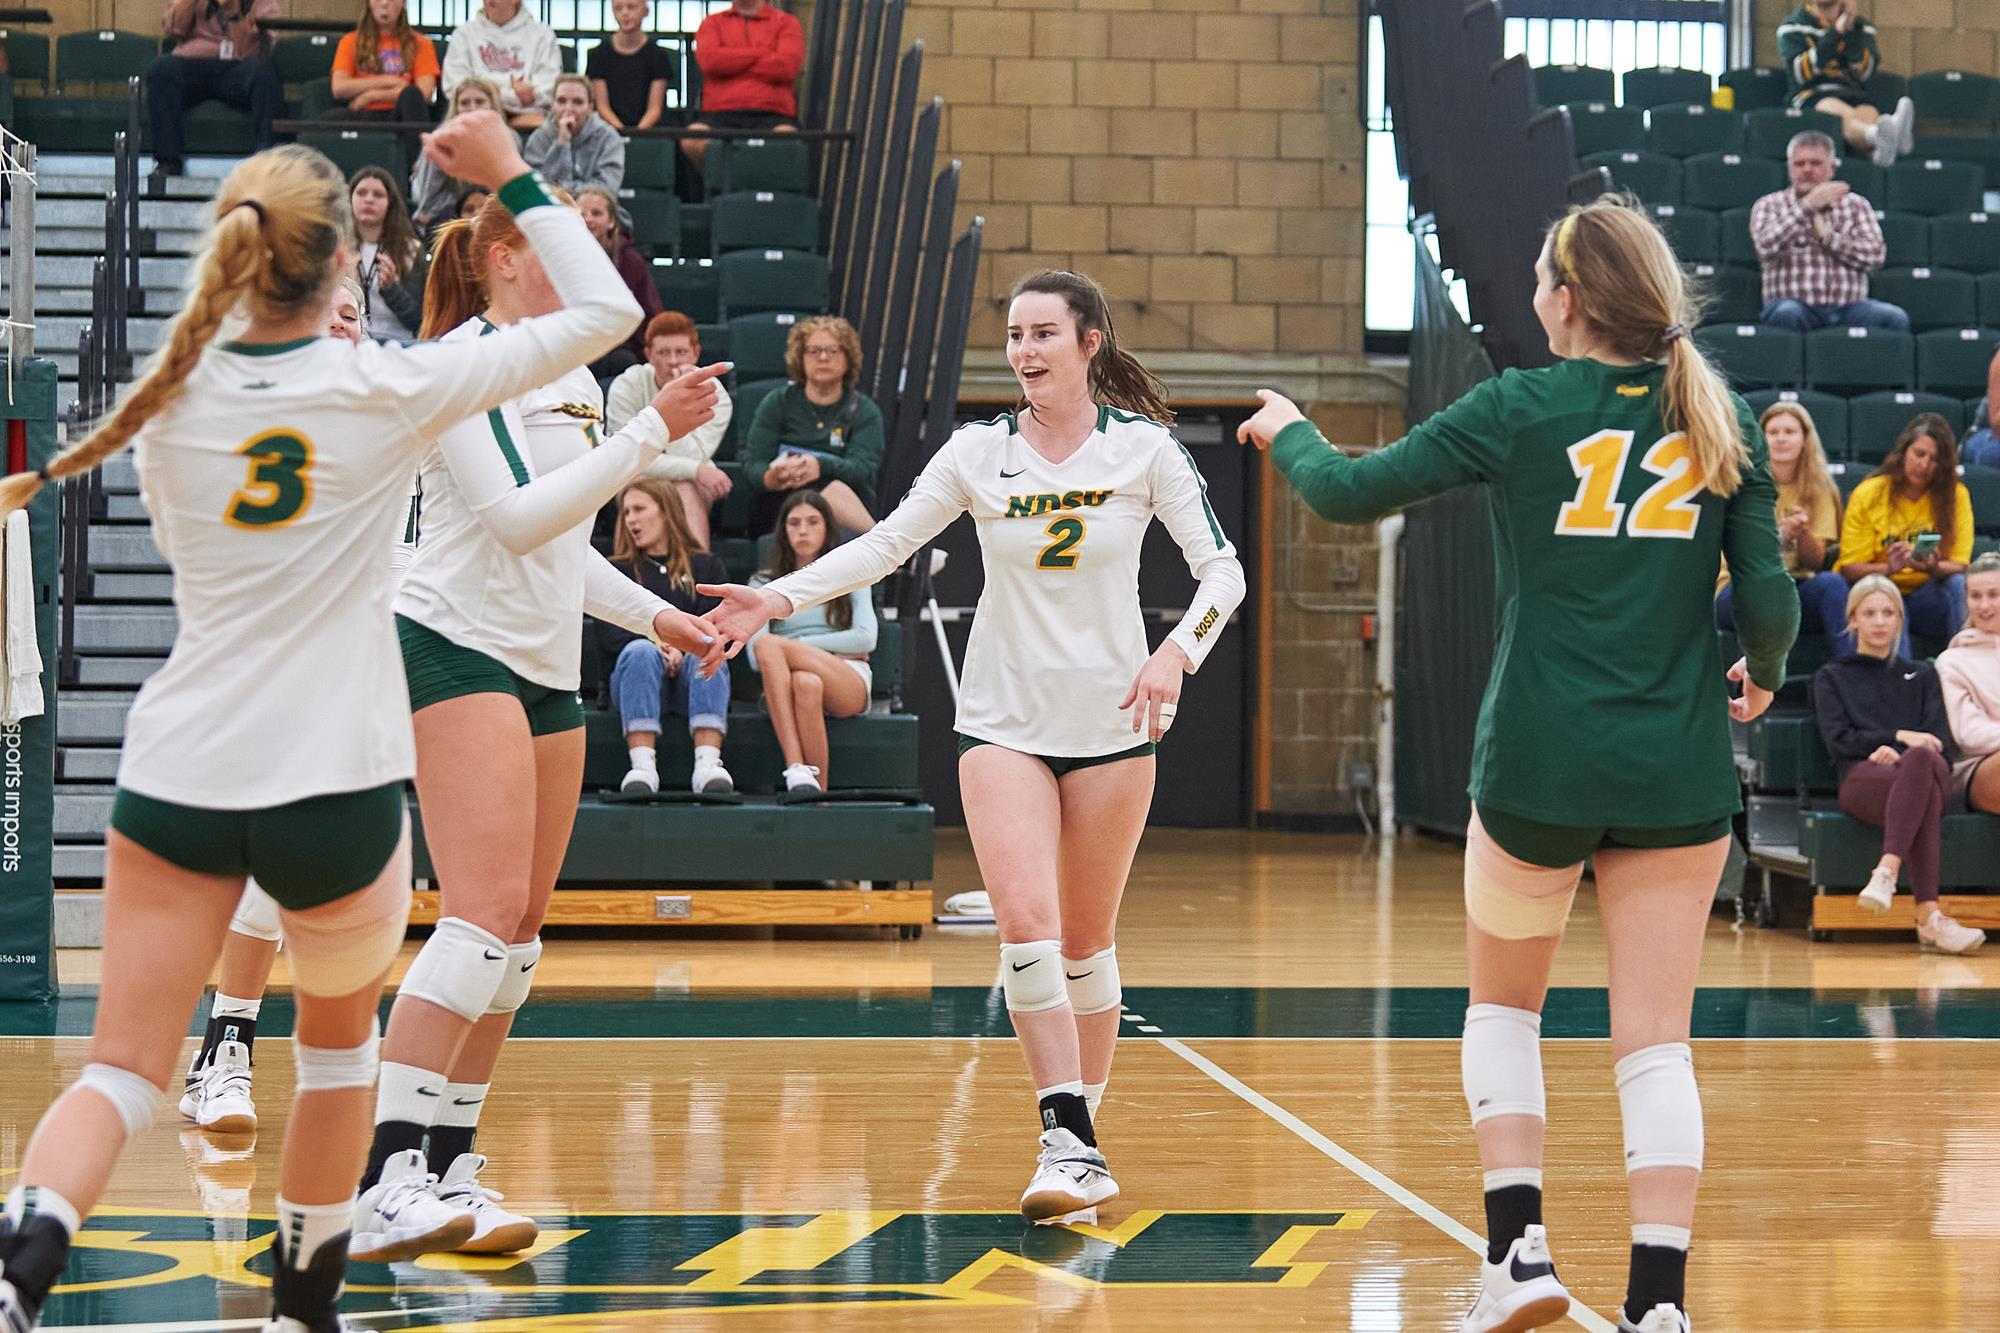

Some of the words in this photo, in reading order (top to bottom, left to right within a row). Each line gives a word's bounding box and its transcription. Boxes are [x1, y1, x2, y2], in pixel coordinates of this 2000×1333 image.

[223, 427, 316, 532] 3
[1004, 489, 1115, 517] NDSU
[1553, 428, 1703, 540] 12
[1035, 514, 1087, 571] 2
[1193, 605, 1220, 643] BISON
[3, 723, 23, 788] sports
[0, 792, 22, 872] imports
